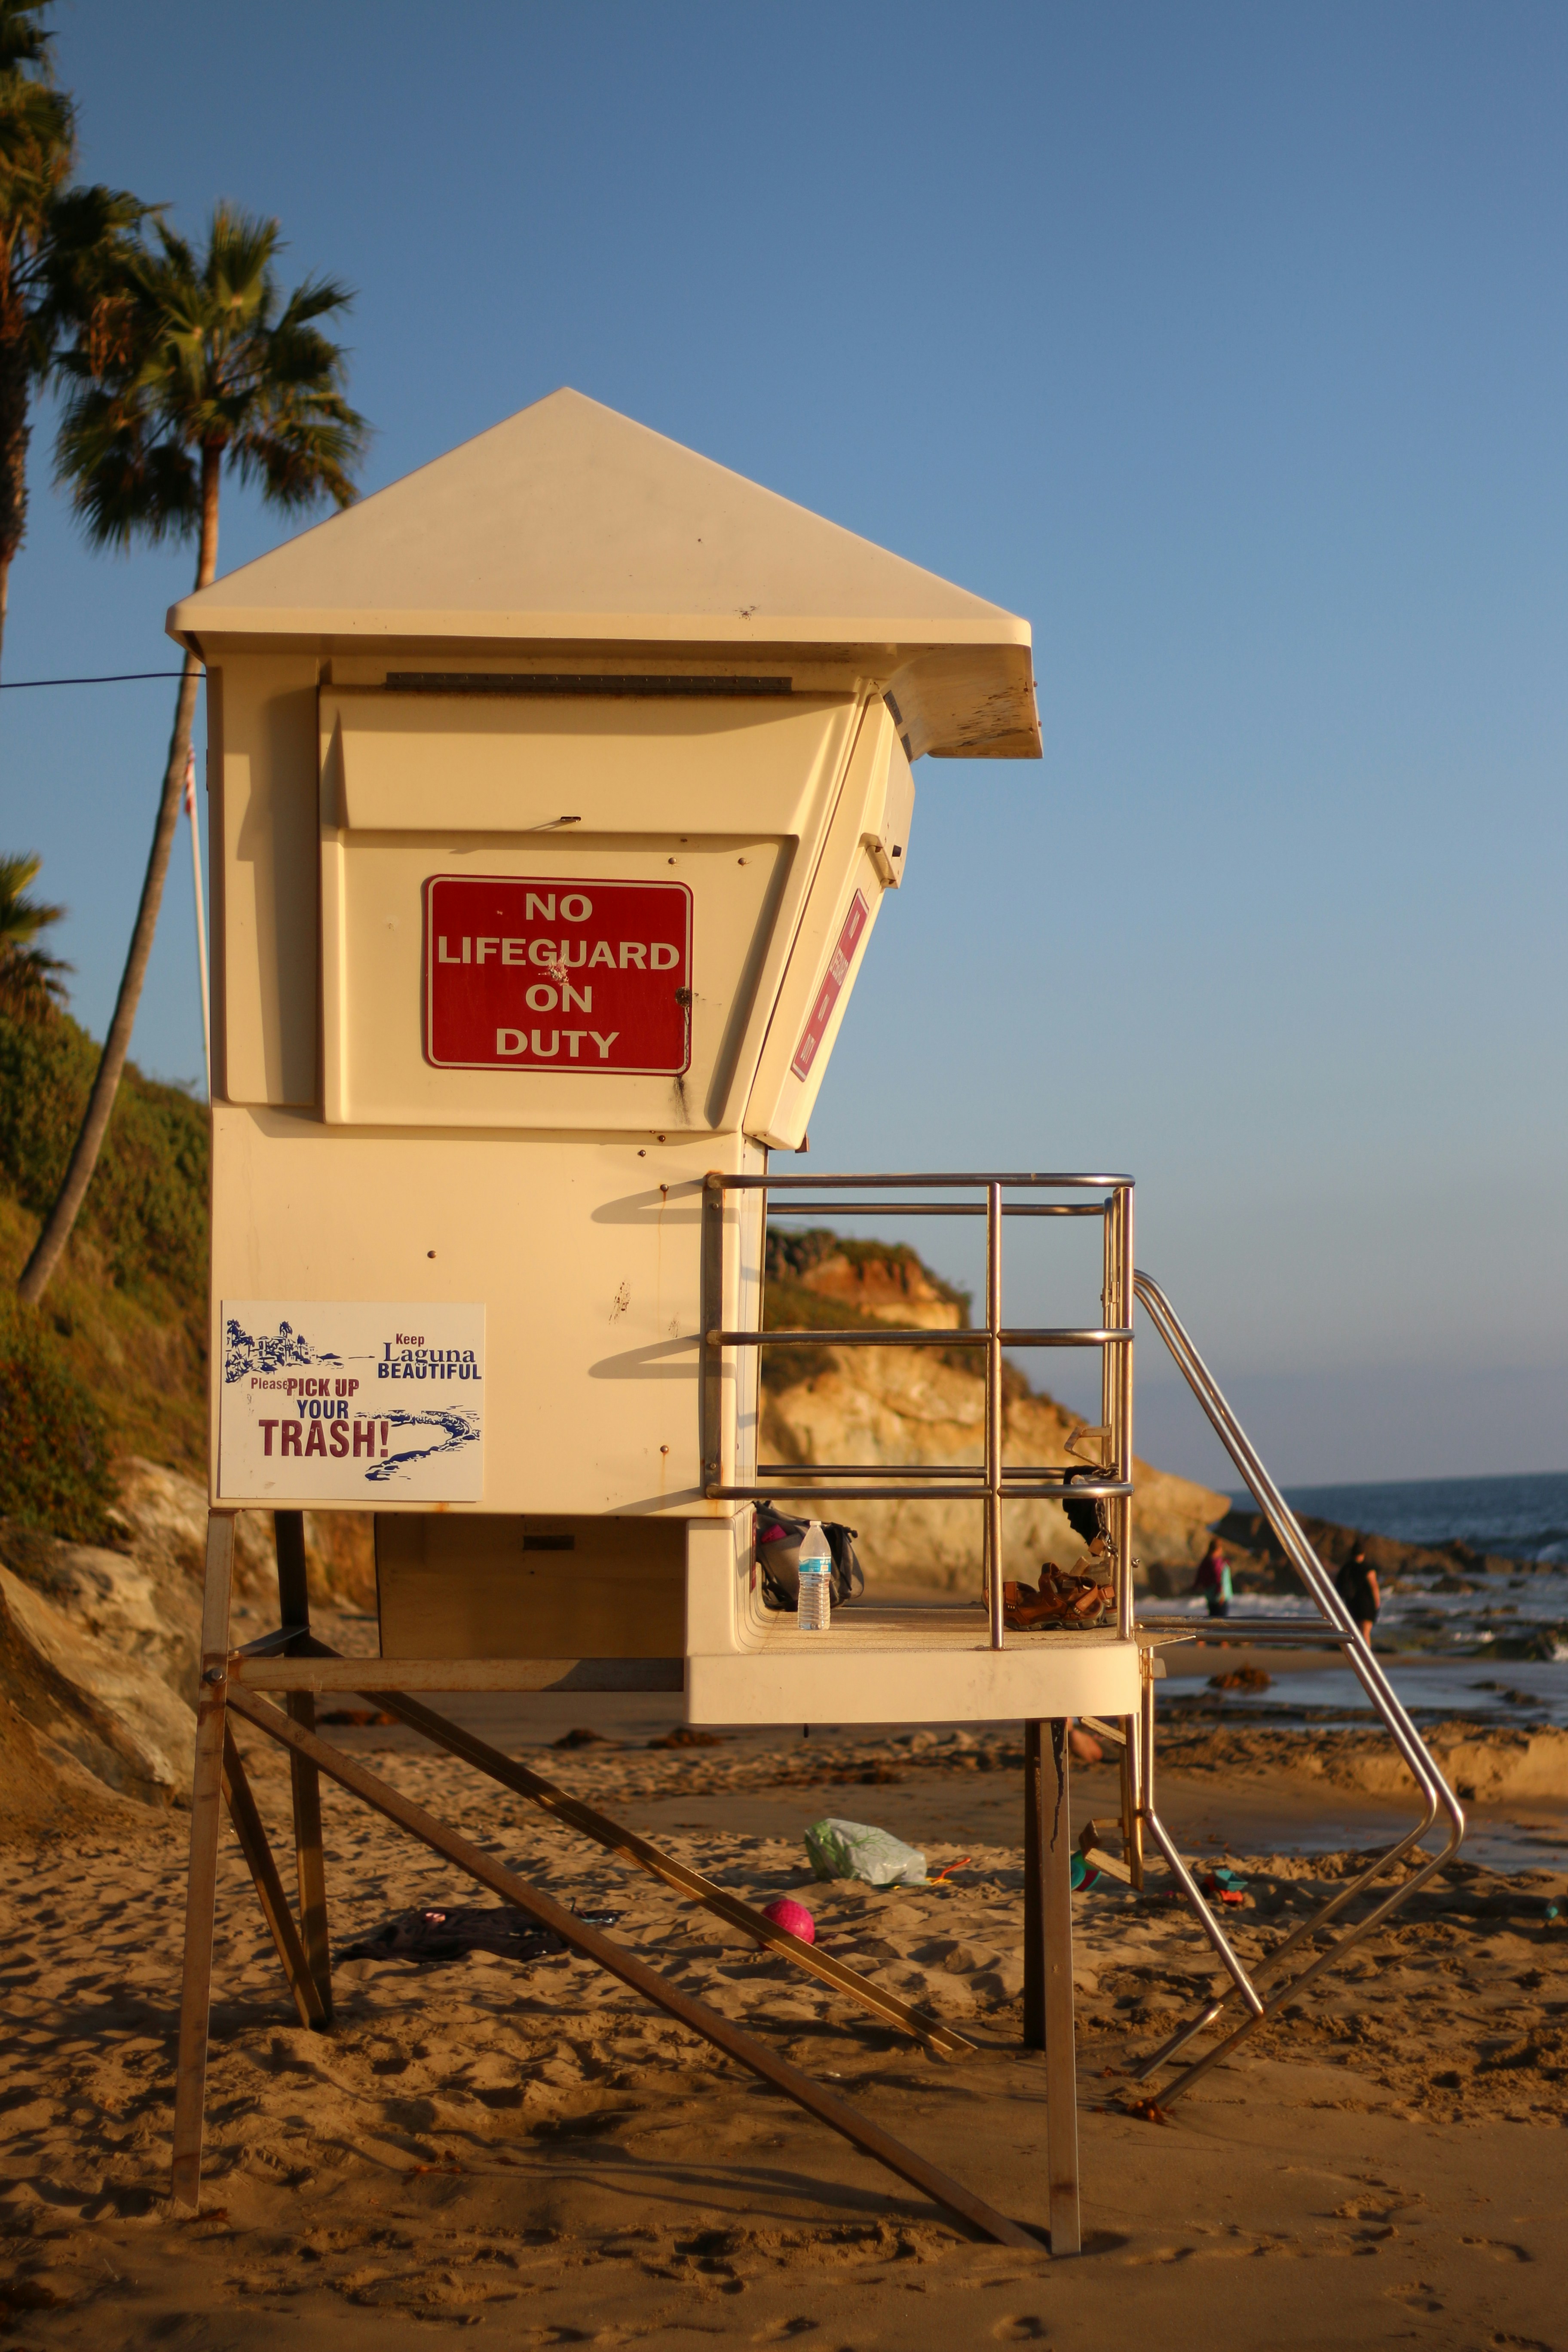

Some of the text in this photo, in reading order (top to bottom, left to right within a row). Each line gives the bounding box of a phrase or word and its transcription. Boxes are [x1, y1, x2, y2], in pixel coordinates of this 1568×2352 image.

[525, 893, 593, 922] NO
[438, 936, 680, 970] LIFEGUARD
[525, 984, 592, 1013] ON
[496, 1028, 620, 1058] DUTY
[395, 1333, 425, 1347] Keep
[383, 1342, 476, 1366] Laguna
[378, 1363, 482, 1380] BEAUTIFUL
[251, 1377, 359, 1397] Please PICK UP
[297, 1399, 349, 1419] YOUR
[258, 1419, 389, 1458] TRASH!
